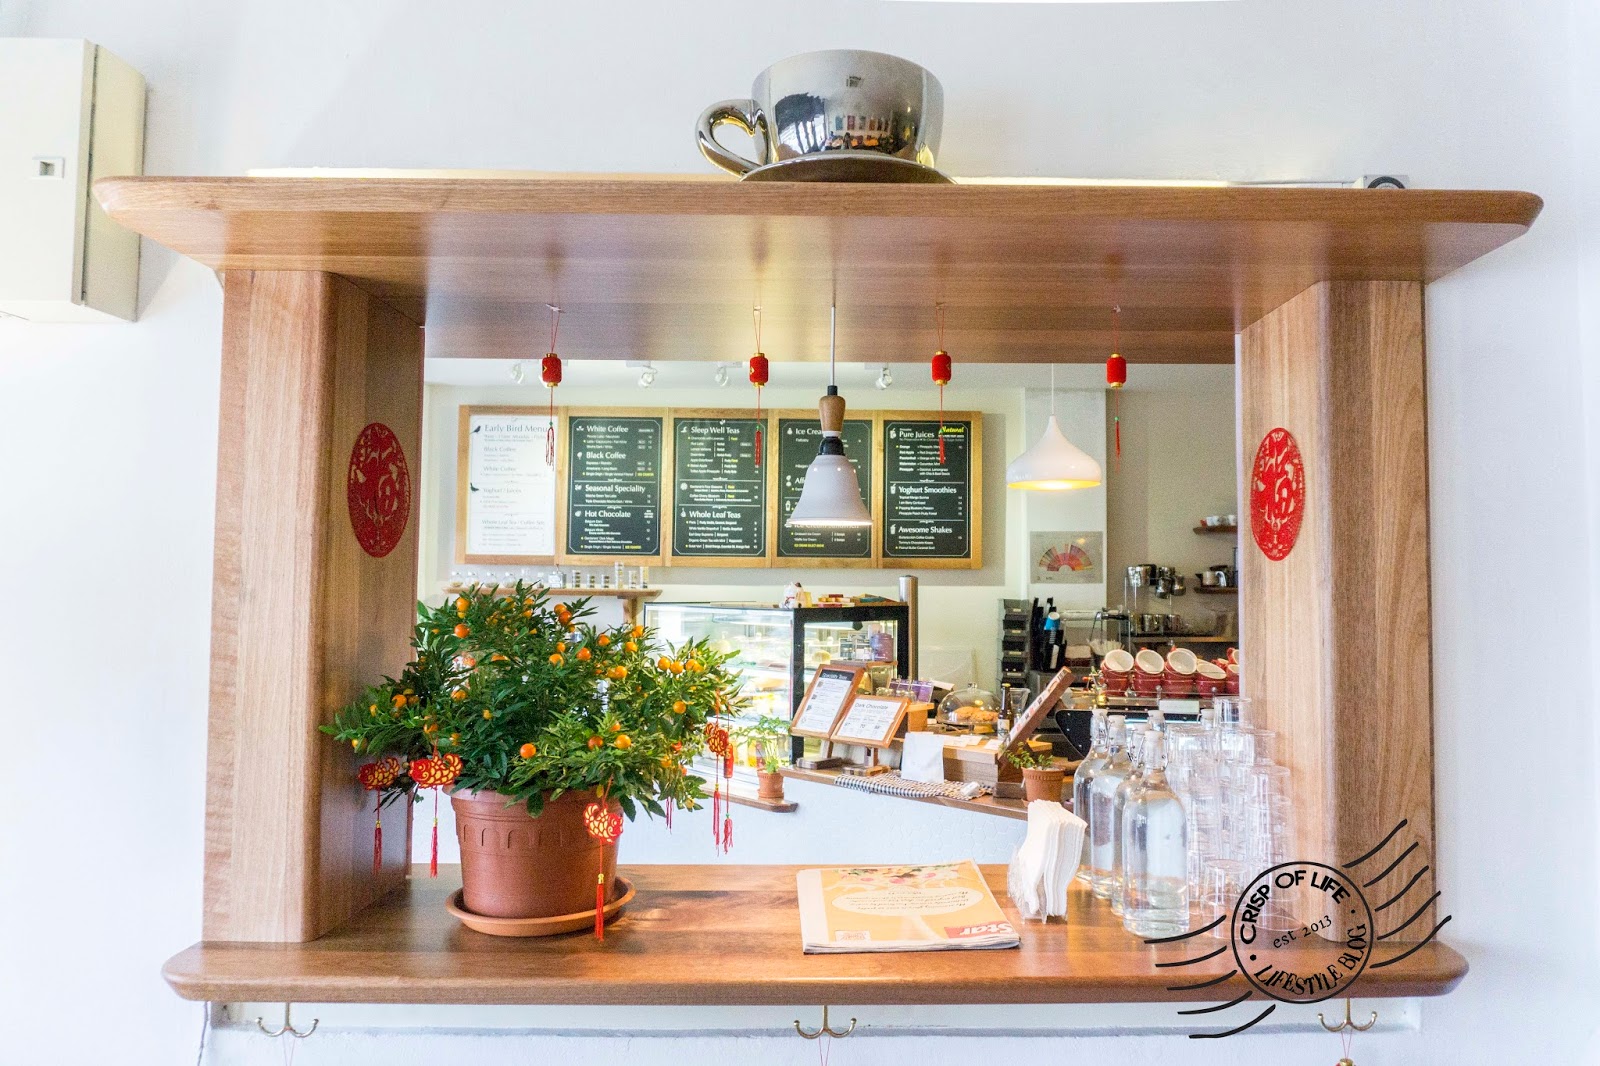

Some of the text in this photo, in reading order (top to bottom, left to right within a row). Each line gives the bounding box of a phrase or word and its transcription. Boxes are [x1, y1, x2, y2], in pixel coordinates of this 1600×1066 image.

[484, 424, 504, 433] Early
[506, 424, 523, 432] Bird
[608, 425, 628, 433] Coffee
[690, 426, 709, 434] Sleep
[585, 484, 646, 494] Seasonal Speciality
[898, 486, 923, 495] Yoghurt
[960, 922, 1014, 936] Star
